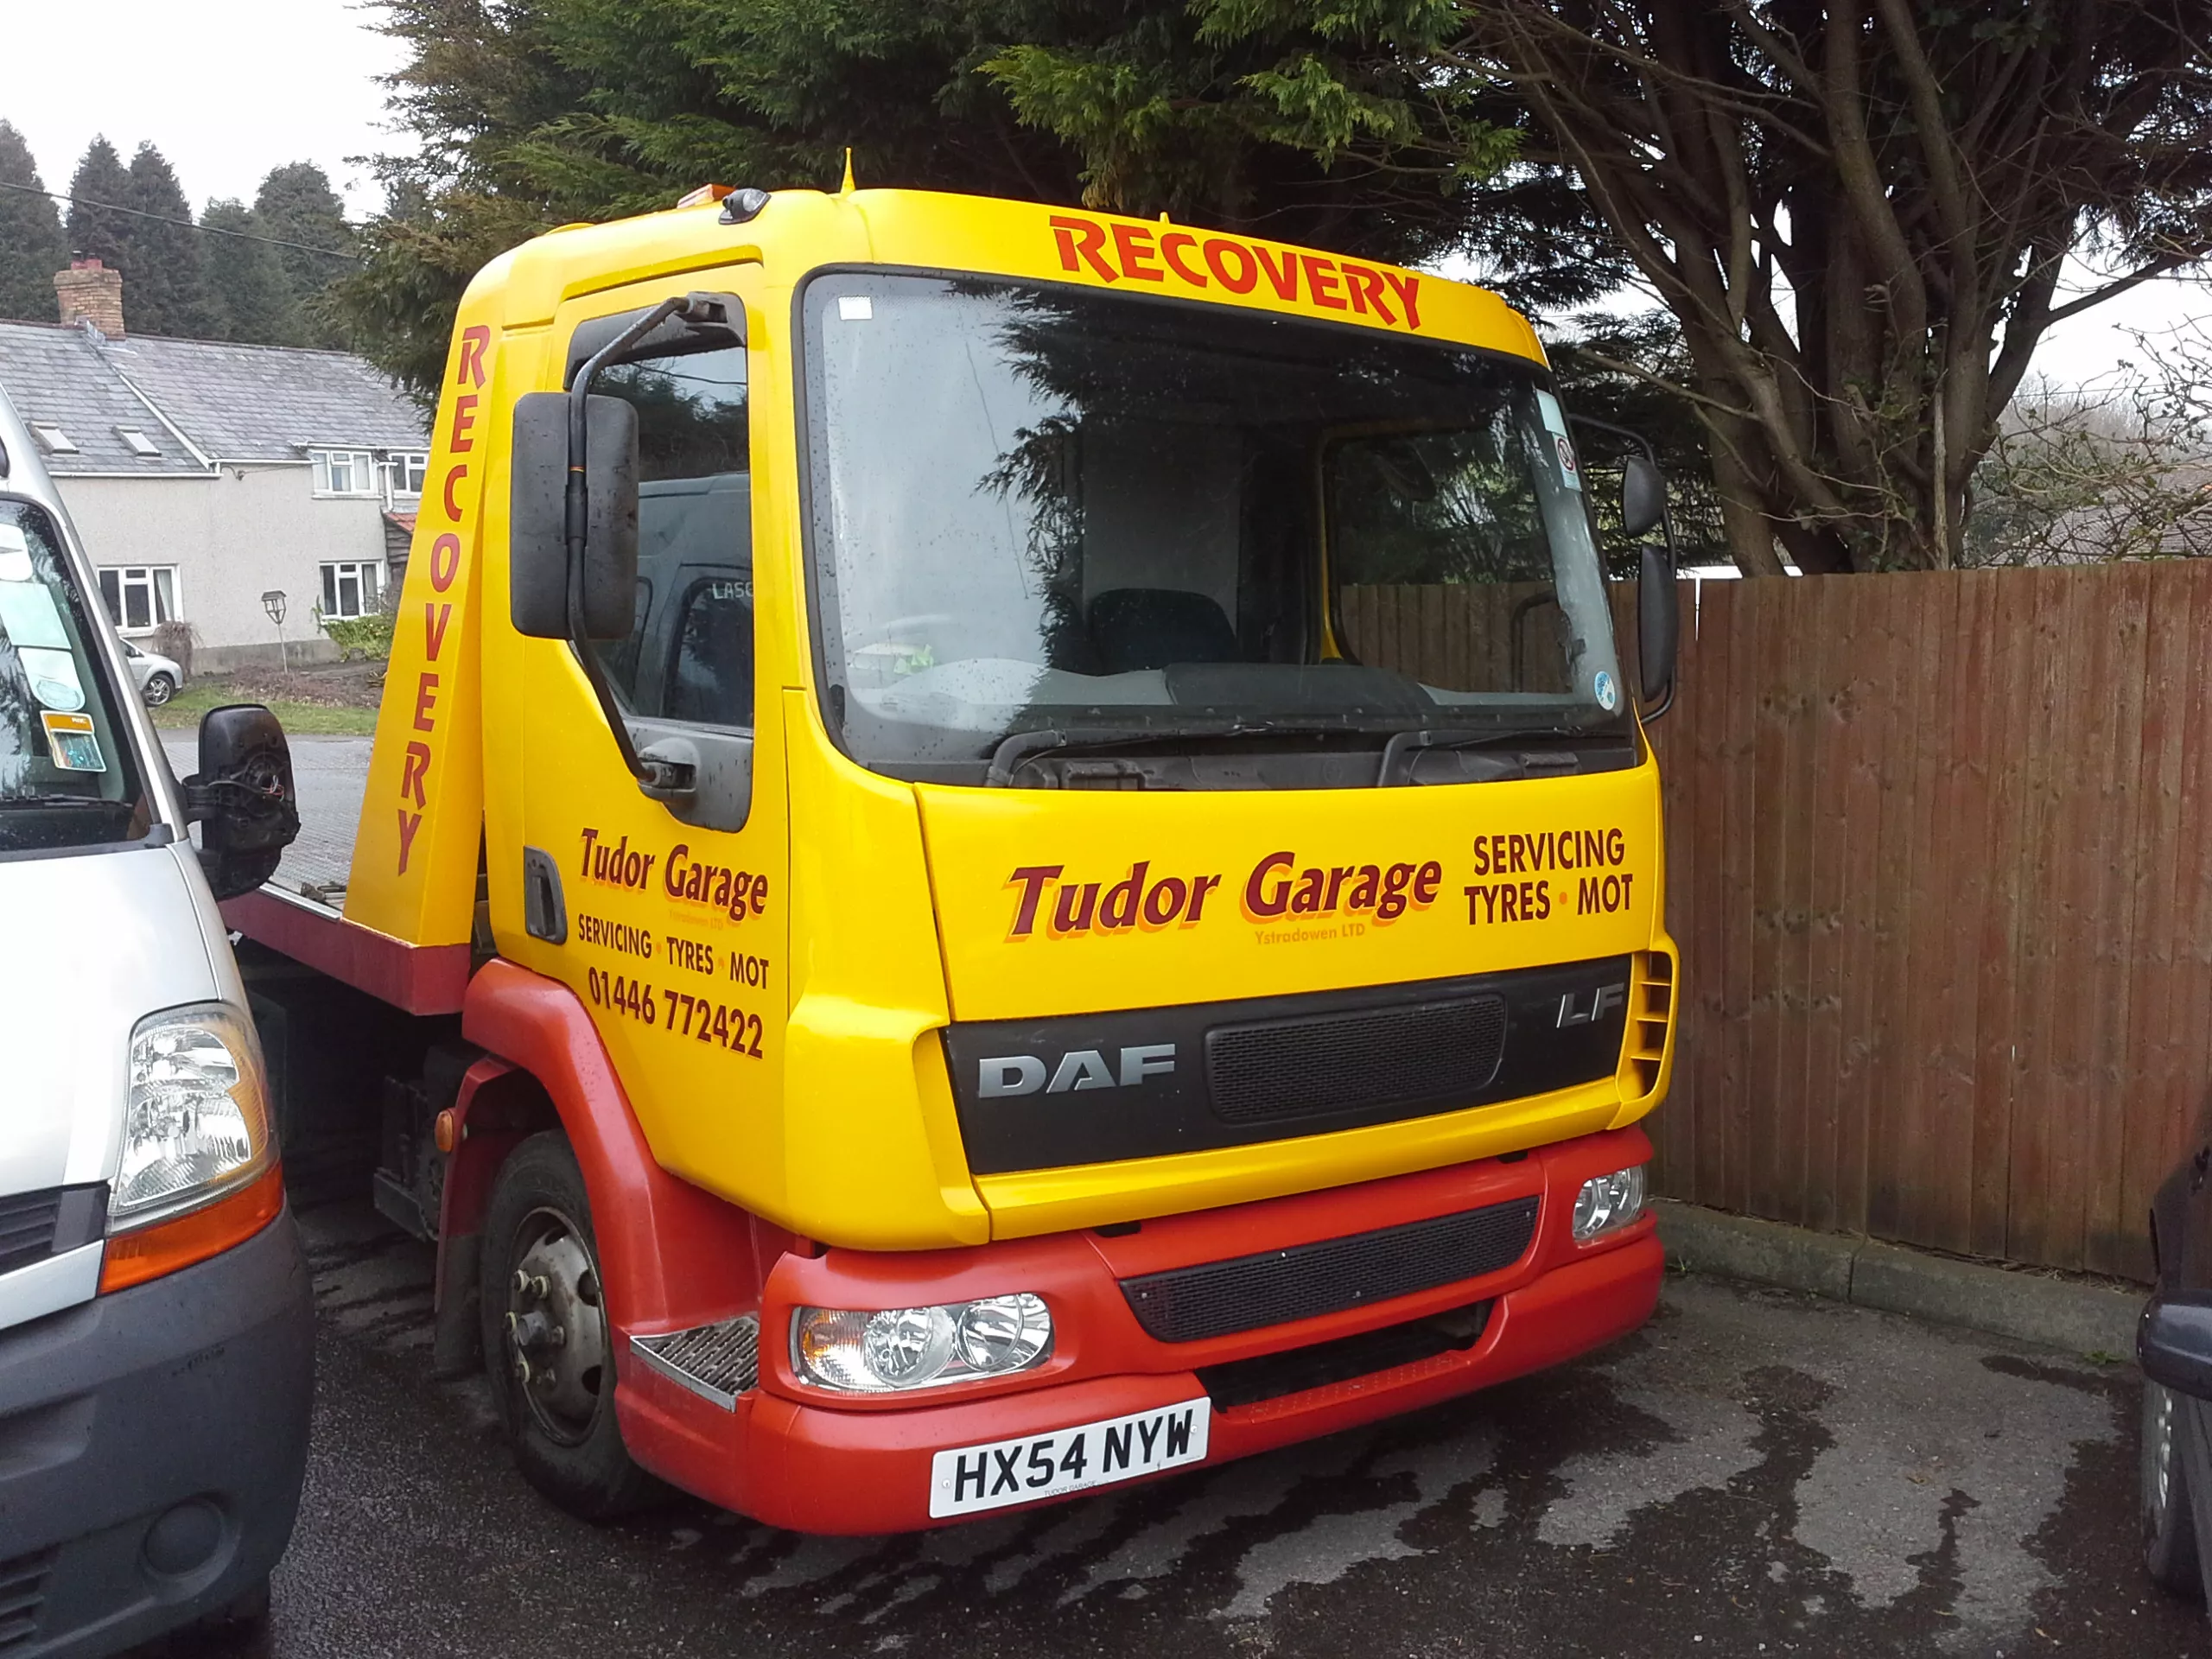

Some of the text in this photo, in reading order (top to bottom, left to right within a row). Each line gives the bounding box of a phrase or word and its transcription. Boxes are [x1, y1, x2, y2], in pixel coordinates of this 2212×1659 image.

[1050, 215, 1420, 330] RECOVERY
[397, 325, 490, 876] RECOVERY
[581, 828, 768, 922] Tudor Garage
[1472, 828, 1625, 874] SERVICING
[1004, 850, 1443, 941] Tudor Garage
[1255, 923, 1365, 944] Ystradowen LTD
[1465, 873, 1633, 925] TYRES MOT
[578, 913, 652, 958] SERVICING
[666, 937, 714, 976] TYRES
[730, 951, 769, 989] MOT
[588, 967, 764, 1059] 01446 772422
[1556, 982, 1625, 1029] LF
[978, 1043, 1176, 1099] DAF
[954, 1408, 1193, 1502] HX54 NYW
[1045, 1485, 1069, 1497] TUDOR
